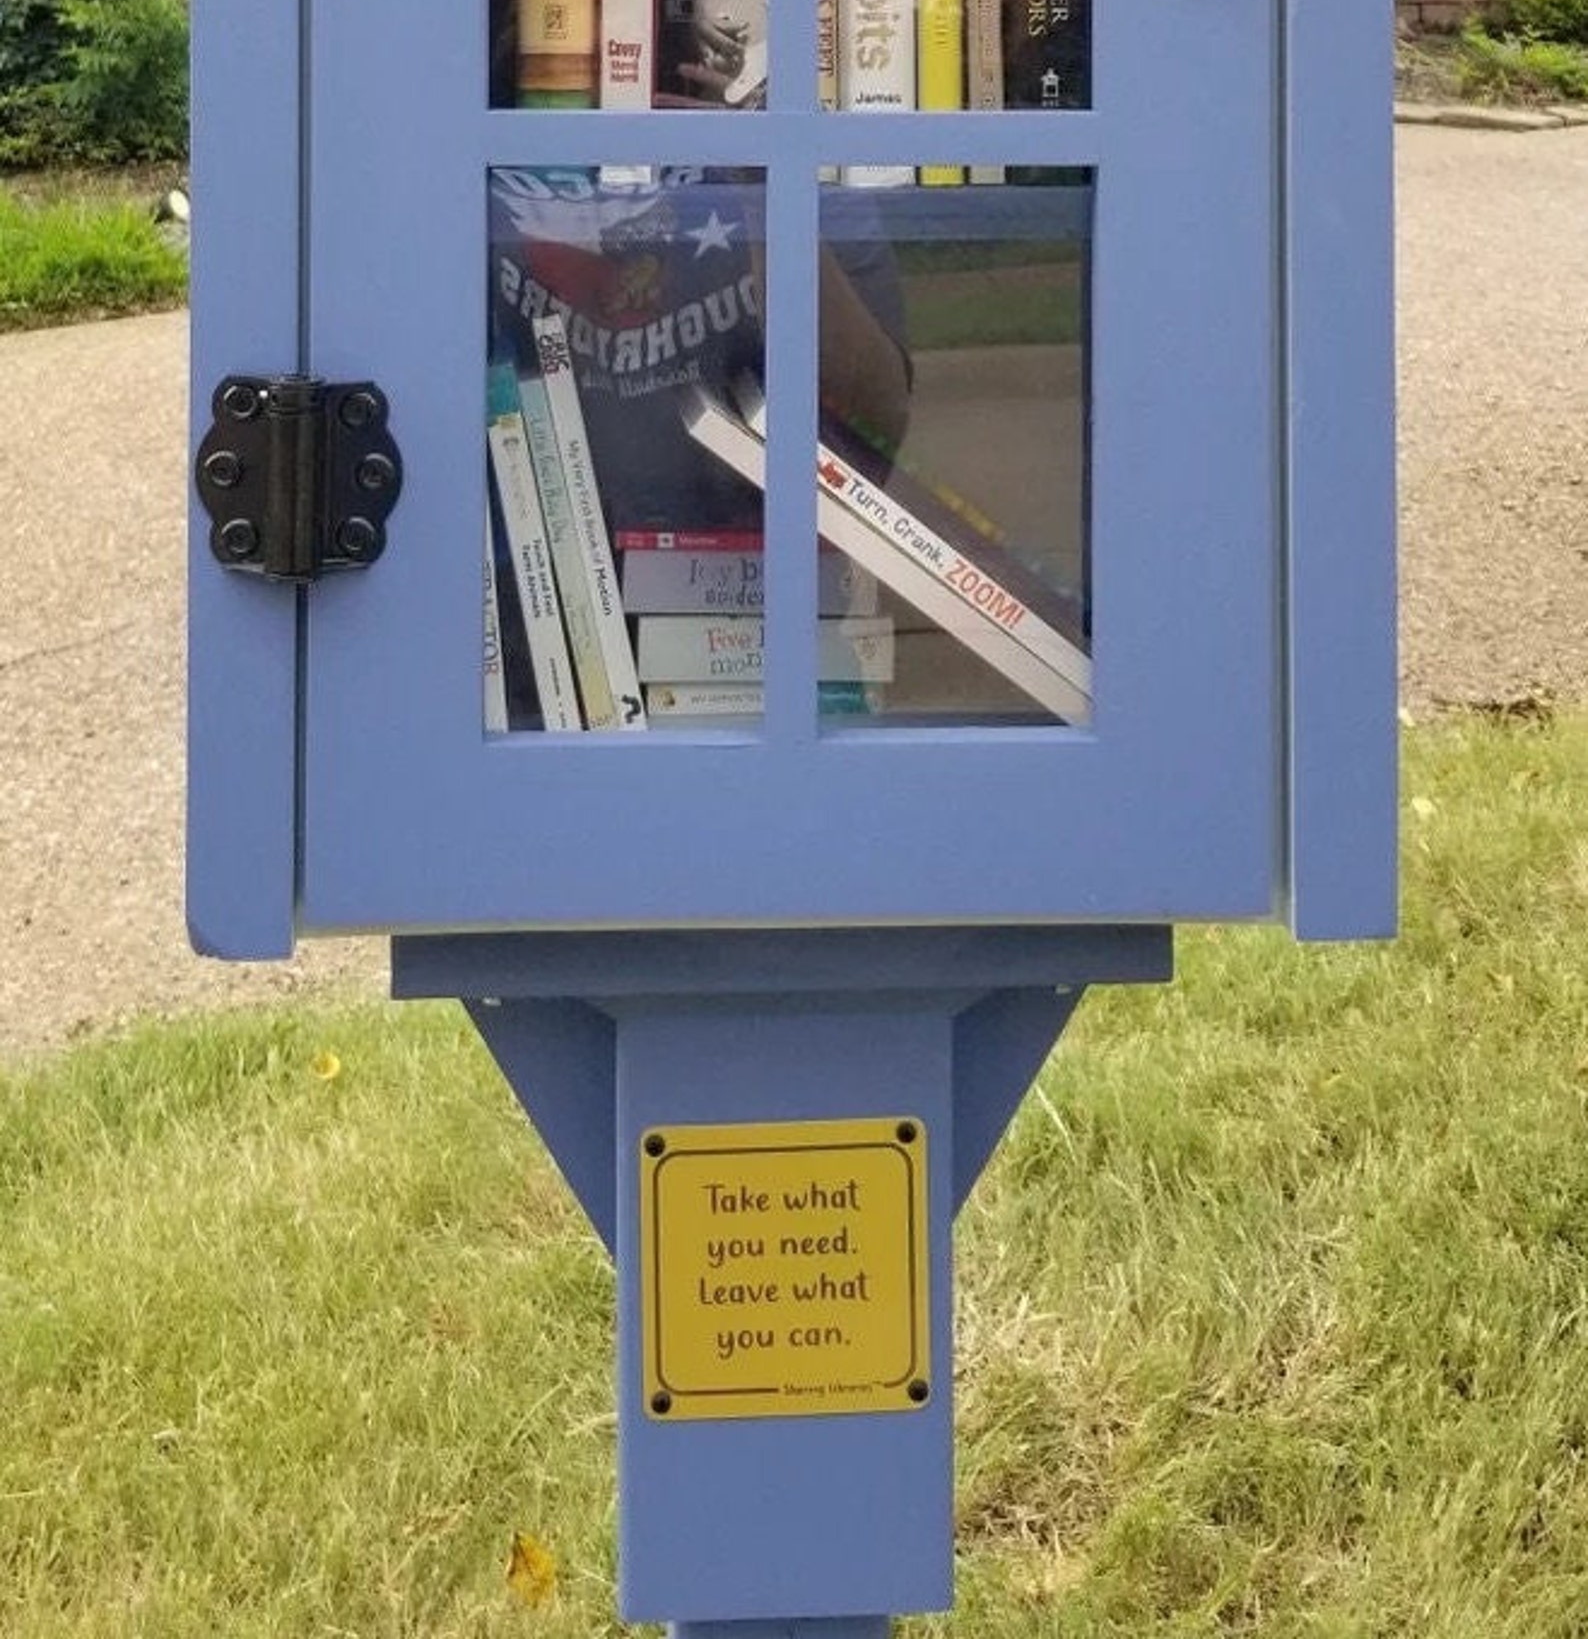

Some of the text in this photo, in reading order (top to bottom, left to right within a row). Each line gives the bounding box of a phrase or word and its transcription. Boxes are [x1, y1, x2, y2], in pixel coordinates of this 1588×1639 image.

[855, 90, 902, 106] James
[591, 564, 614, 616] Motion
[943, 558, 1027, 630] ZOOM!
[703, 1179, 861, 1215] Take what
[706, 1226, 859, 1269] you need.
[698, 1271, 871, 1306] Leave what
[716, 1323, 852, 1361] you can.
